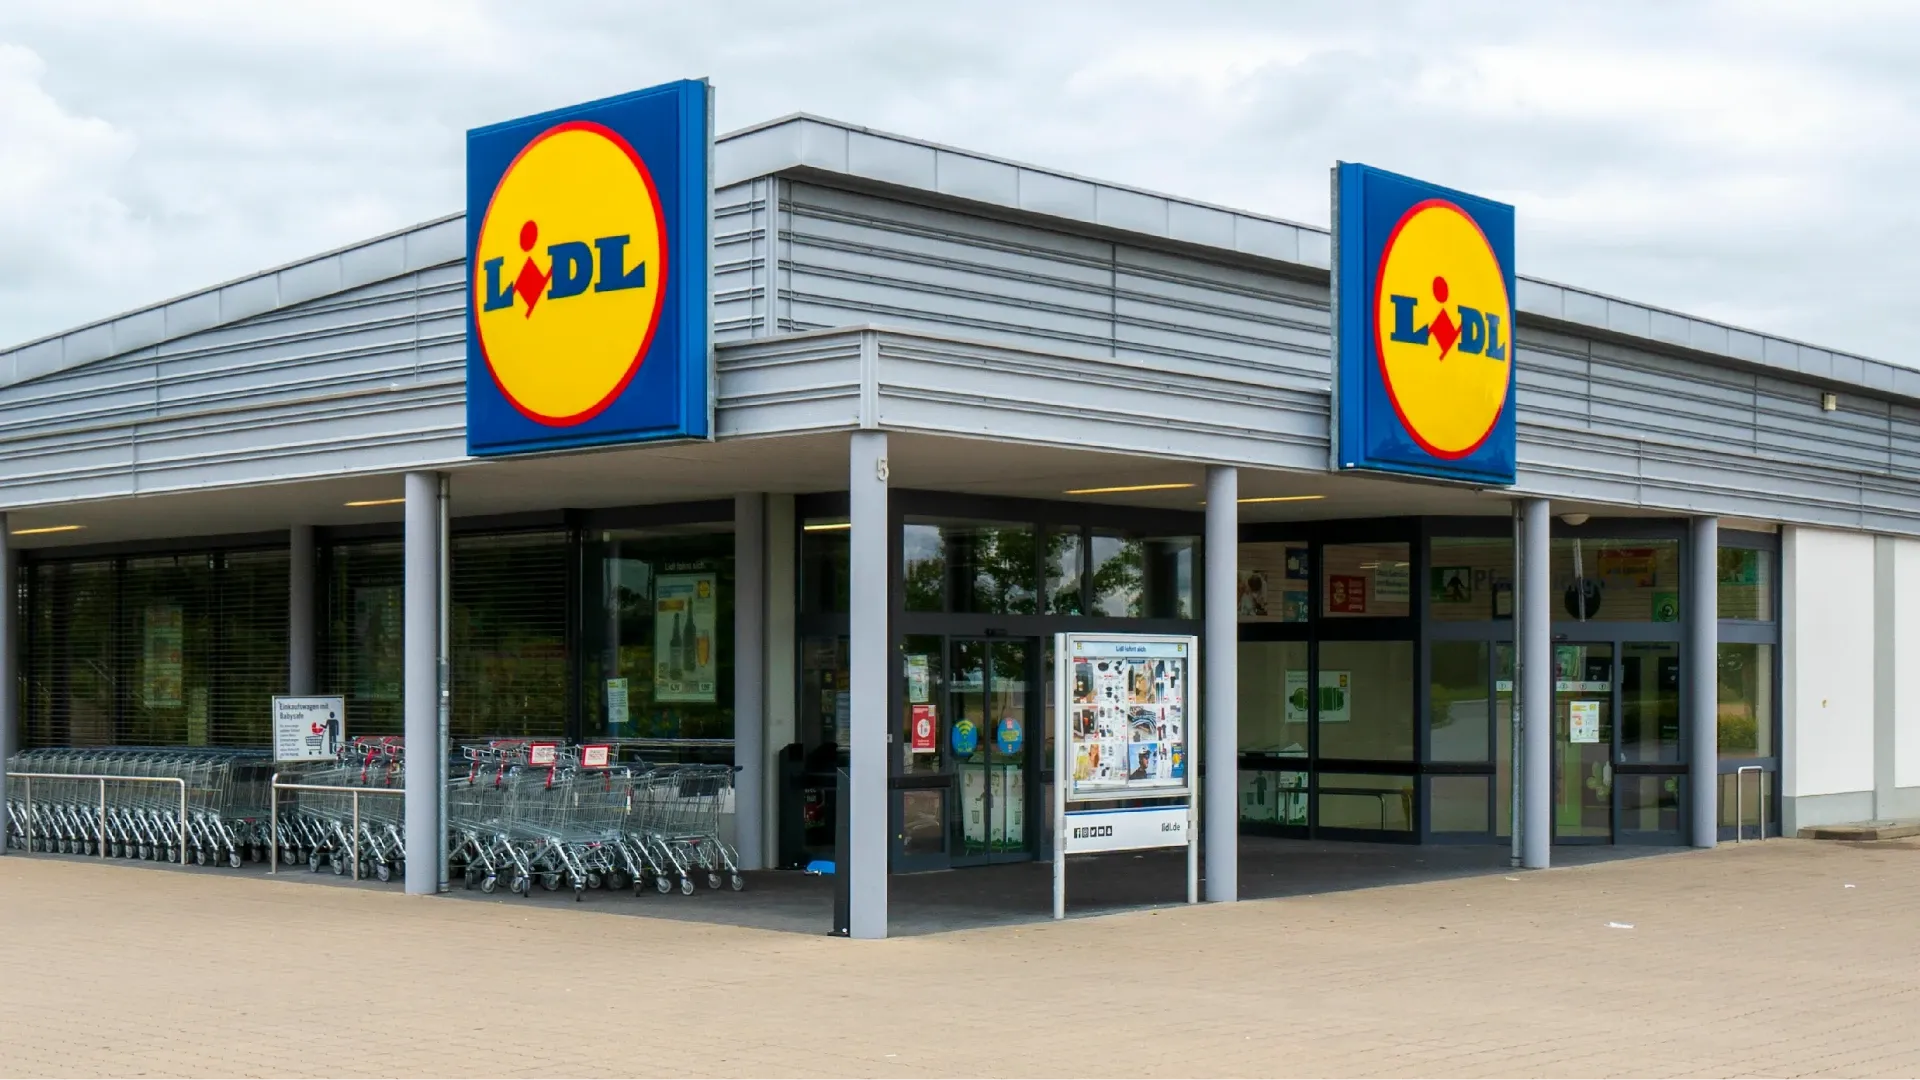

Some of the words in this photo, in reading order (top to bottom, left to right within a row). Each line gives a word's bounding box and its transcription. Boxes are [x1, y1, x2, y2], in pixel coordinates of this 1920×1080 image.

[877, 457, 889, 481] 5
[280, 703, 319, 711] Einkaufswagen
[280, 712, 304, 721] Babysafe
[1161, 822, 1181, 832] lidl.de
